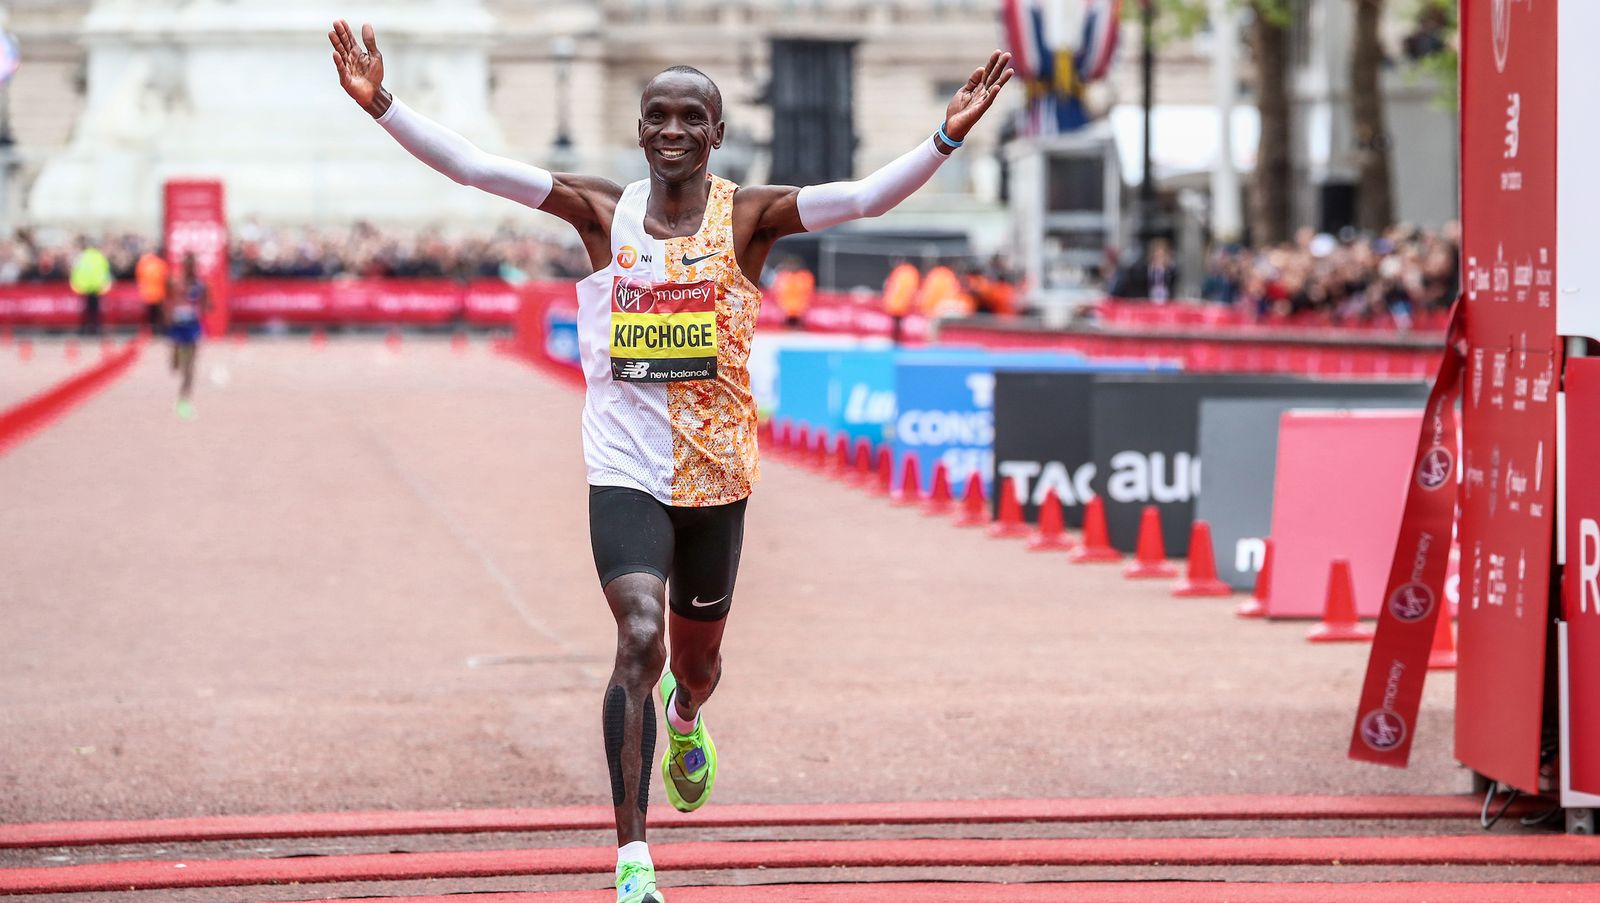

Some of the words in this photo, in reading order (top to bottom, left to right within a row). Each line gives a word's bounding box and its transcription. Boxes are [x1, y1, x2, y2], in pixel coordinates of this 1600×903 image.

[656, 287, 711, 303] money
[614, 324, 713, 348] KIPCHOGE
[650, 371, 668, 379] new
[1107, 450, 1201, 502] au
